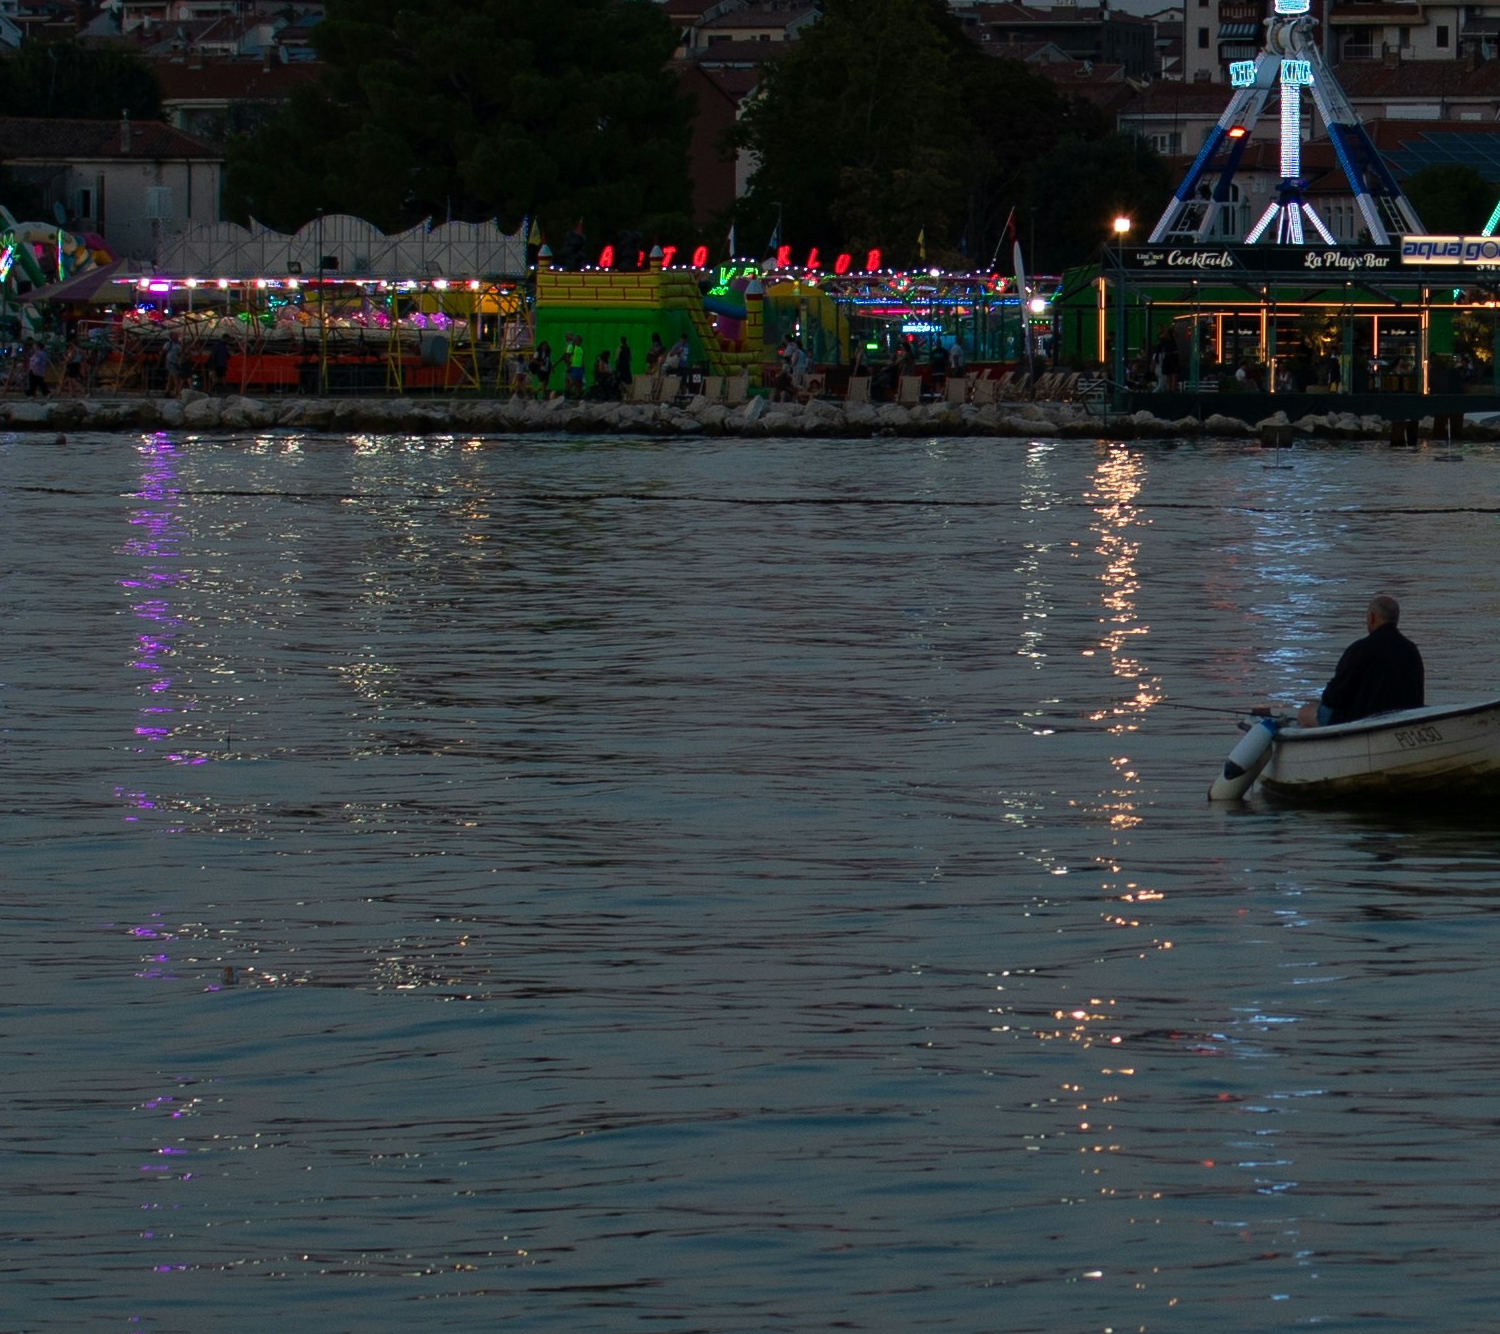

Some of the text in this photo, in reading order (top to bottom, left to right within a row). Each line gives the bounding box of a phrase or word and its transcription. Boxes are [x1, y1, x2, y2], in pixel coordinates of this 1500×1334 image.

[1280, 60, 1311, 85] KING
[1167, 250, 1234, 270] Cocktails
[1304, 252, 1322, 269] La
[1364, 253, 1391, 268] Bar
[1402, 242, 1463, 260] aqua
